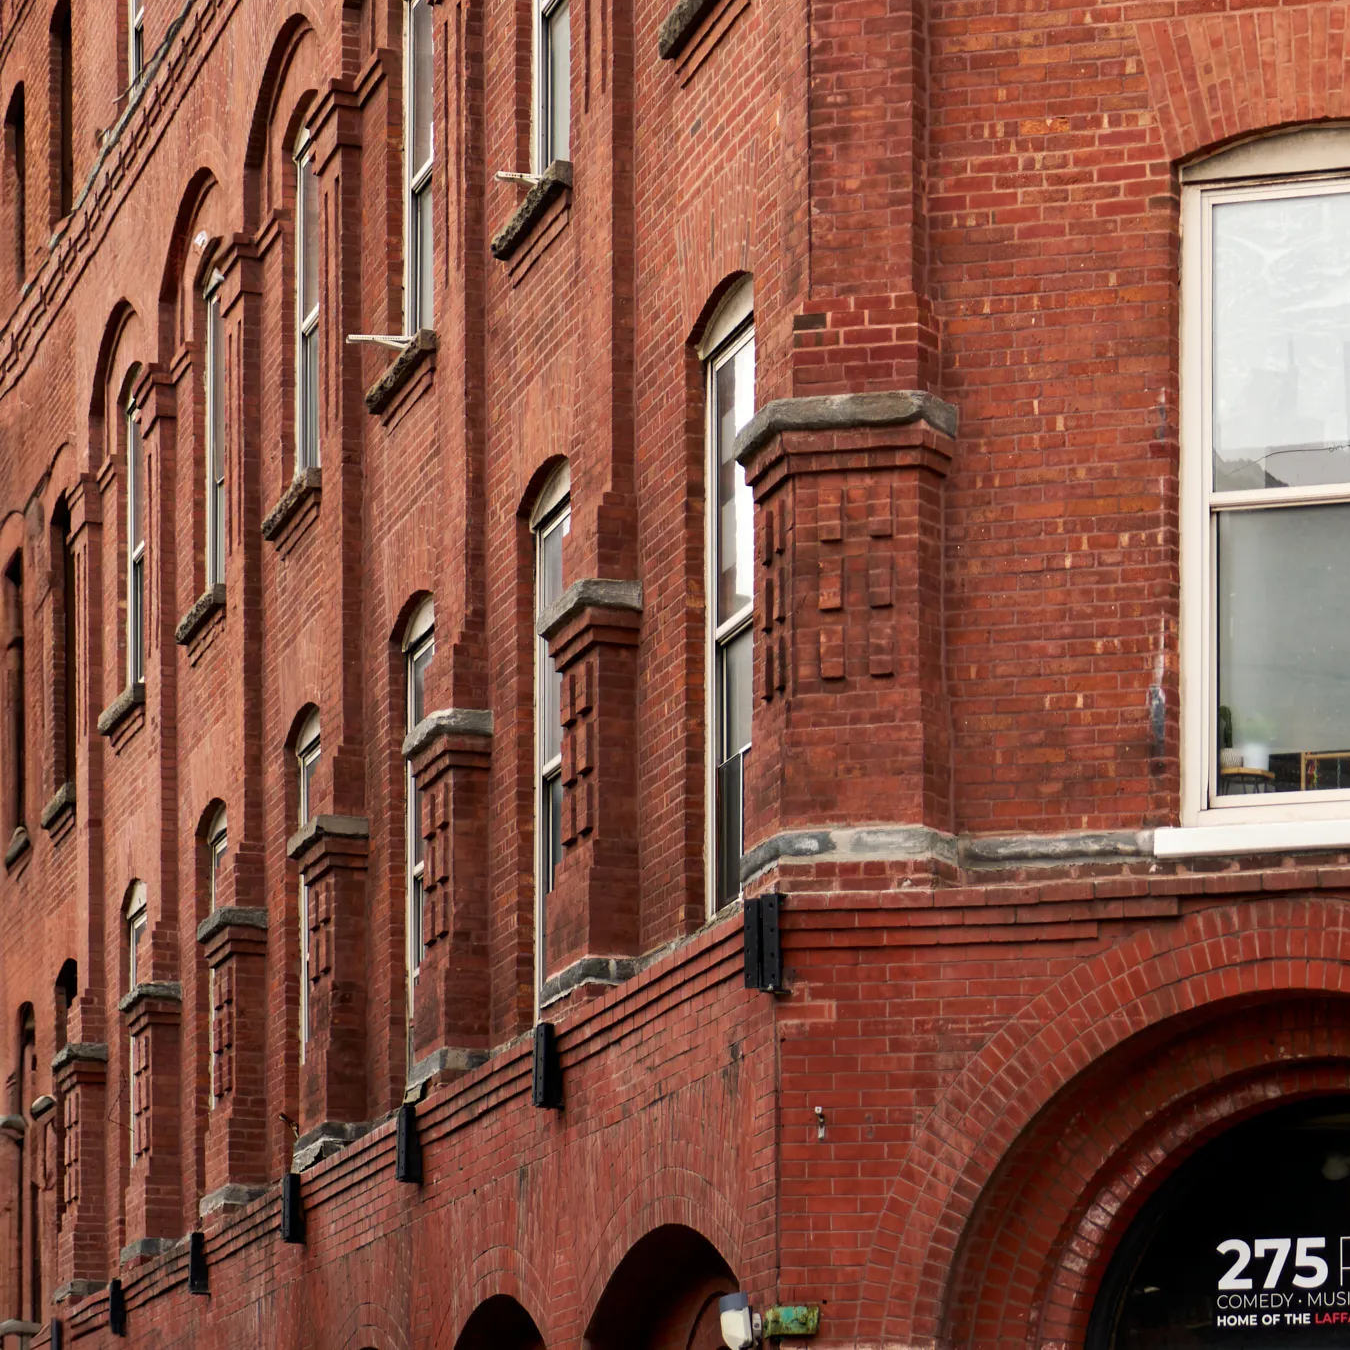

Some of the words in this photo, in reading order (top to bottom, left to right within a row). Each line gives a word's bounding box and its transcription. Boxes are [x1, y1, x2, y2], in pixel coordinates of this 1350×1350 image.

[1215, 1236, 1329, 1291] 275
[1216, 1292, 1294, 1310] COMEDY
[1216, 1314, 1258, 1327] HOME
[1261, 1313, 1281, 1326] OF
[1283, 1312, 1312, 1325] THE
